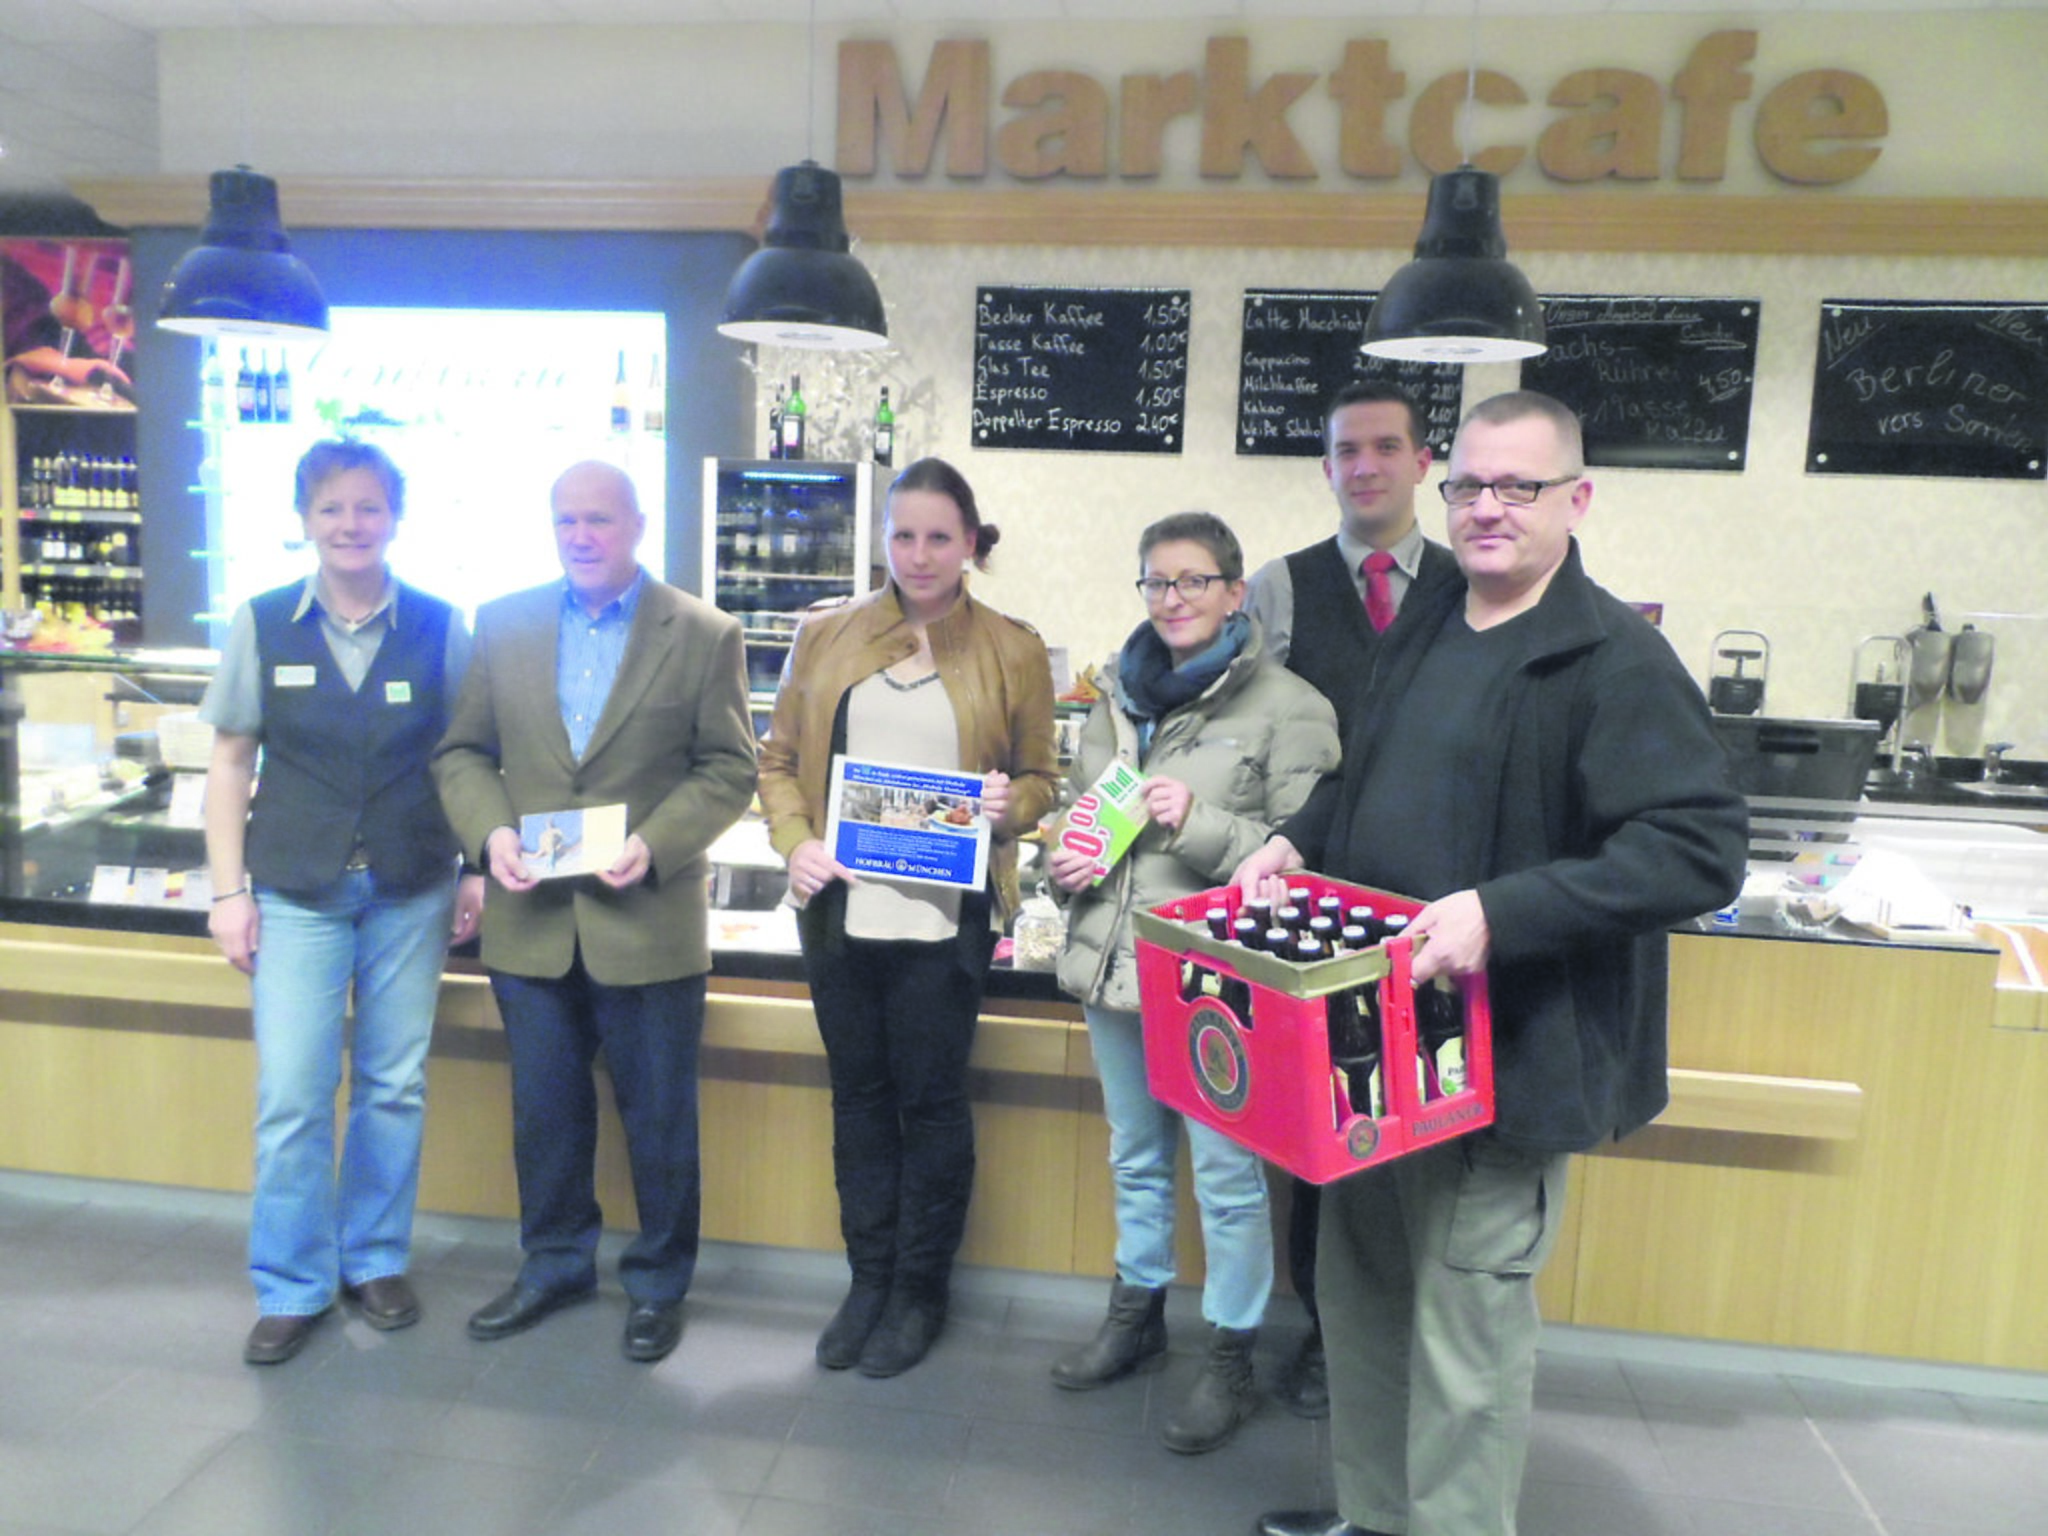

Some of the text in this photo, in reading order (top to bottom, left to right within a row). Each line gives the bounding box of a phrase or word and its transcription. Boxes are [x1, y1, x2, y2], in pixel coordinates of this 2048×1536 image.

[836, 29, 1890, 186] Marktcafe
[978, 303, 1033, 326] Becher
[1043, 302, 1104, 329] Kaffee
[1245, 306, 1366, 331] Latte Macchiat
[977, 333, 1022, 351] Tasse
[1031, 333, 1085, 355] Kaffee
[1824, 316, 1874, 361] Neu
[976, 355, 1010, 384] Glas
[1017, 356, 1050, 378] Tee
[1846, 349, 2027, 402] Berliner
[974, 384, 1048, 406] Espresso
[1243, 400, 1285, 415] Kakao
[972, 407, 1042, 433] Doppelter
[1047, 407, 1121, 439] Espresso
